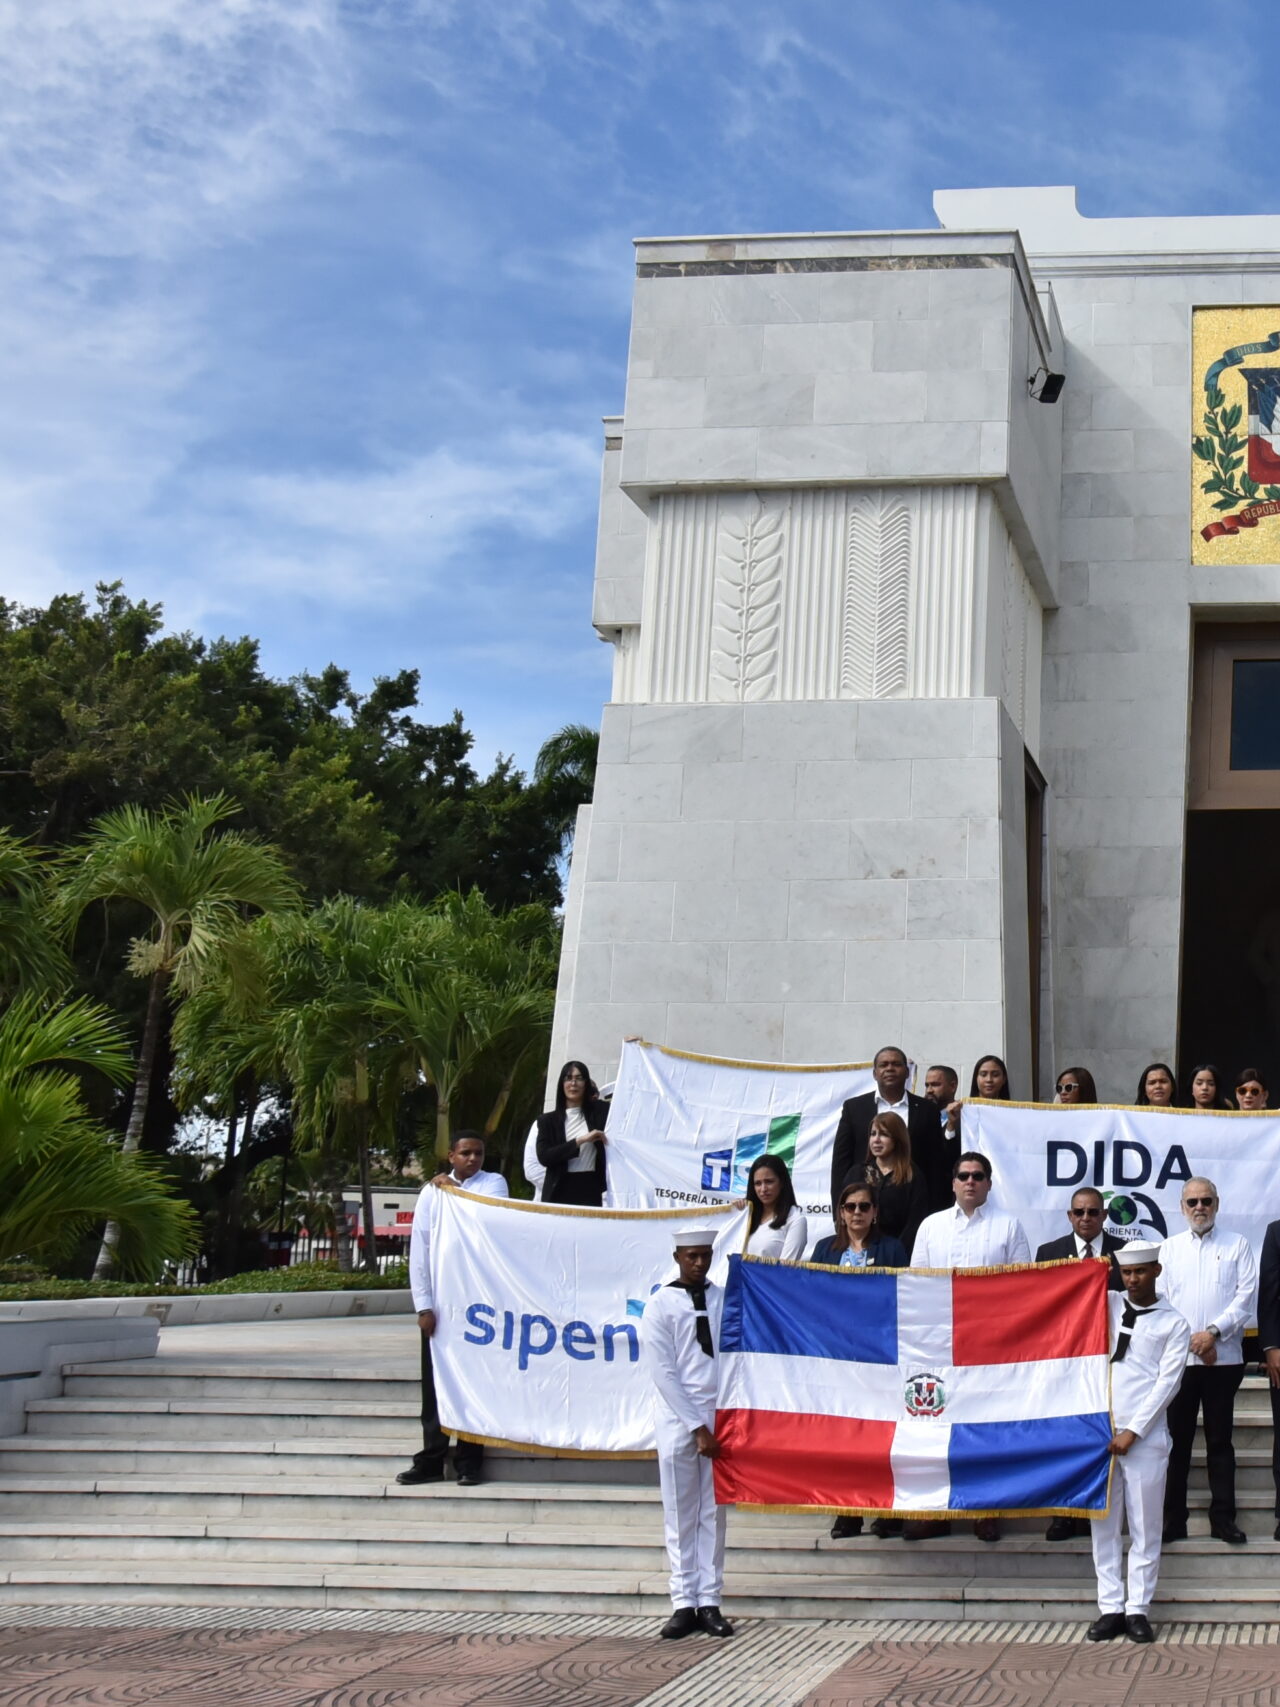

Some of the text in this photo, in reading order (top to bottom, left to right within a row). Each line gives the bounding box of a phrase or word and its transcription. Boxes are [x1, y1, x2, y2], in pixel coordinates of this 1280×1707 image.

[1236, 344, 1263, 357] DIOS
[1046, 1140, 1193, 1189] DIDA
[655, 1187, 708, 1206] TESORERÍA
